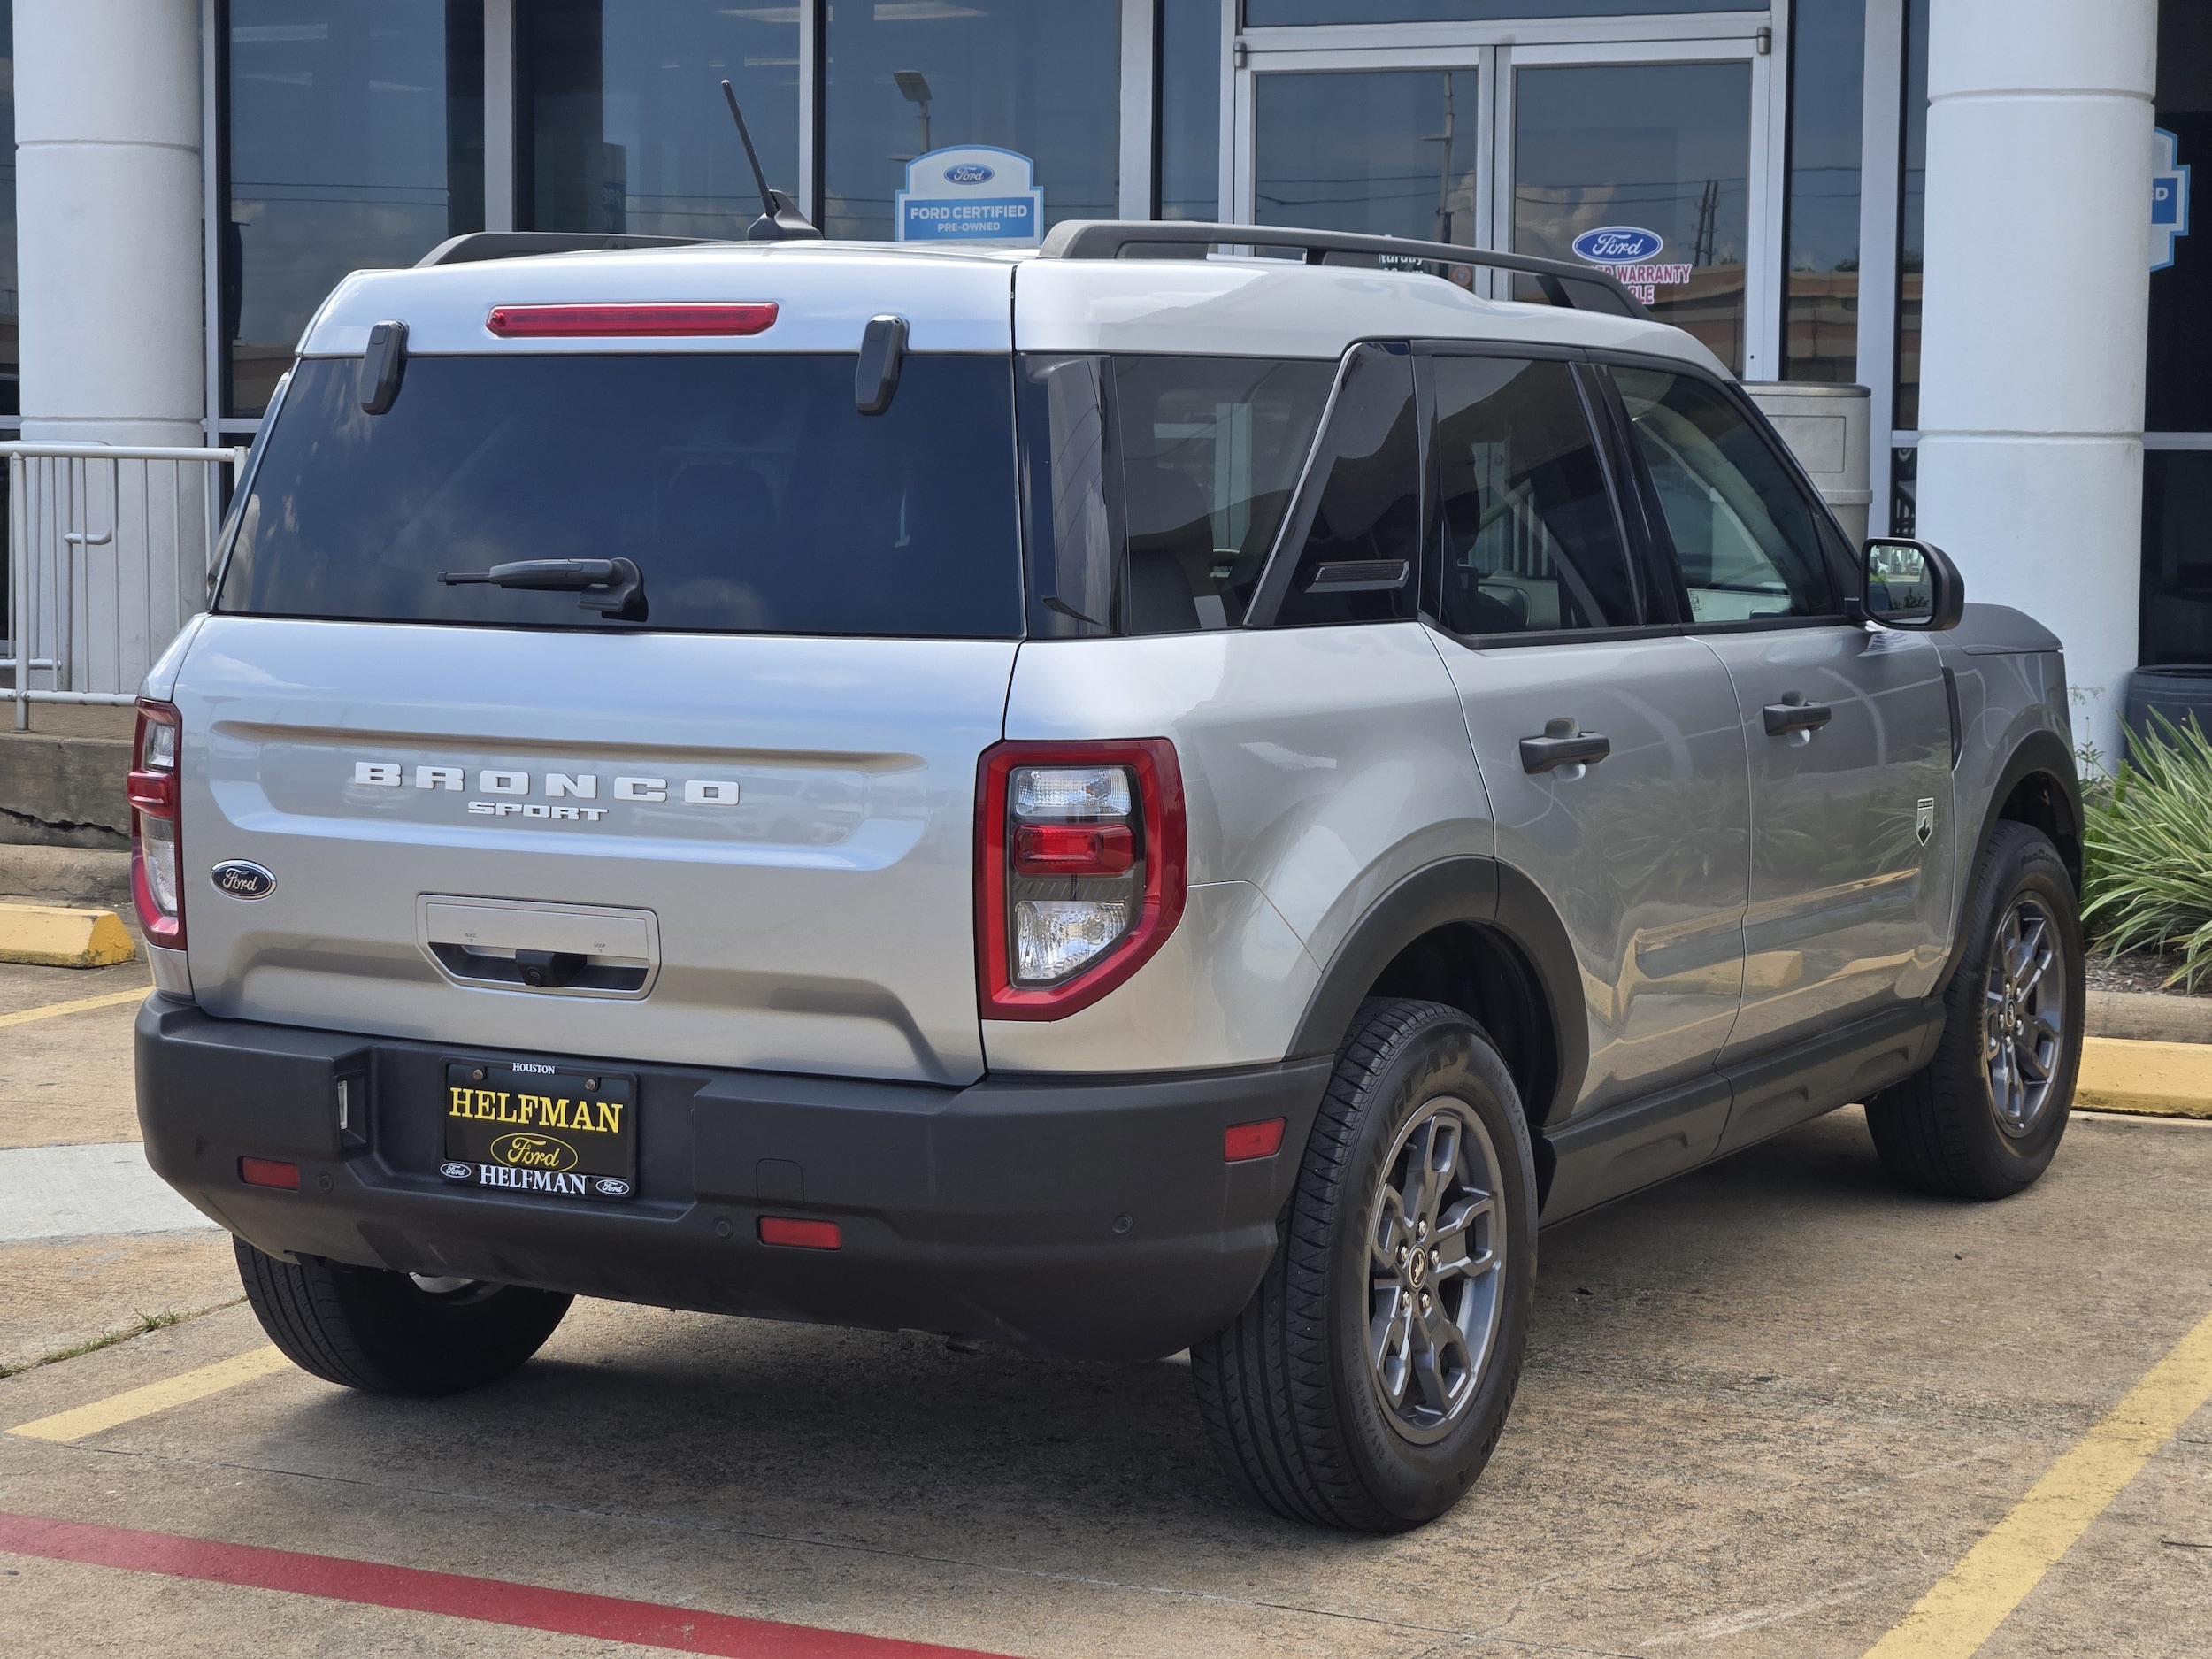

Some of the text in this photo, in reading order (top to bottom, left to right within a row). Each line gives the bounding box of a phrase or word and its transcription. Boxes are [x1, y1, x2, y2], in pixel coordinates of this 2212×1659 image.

[953, 166, 985, 181] Ford
[910, 204, 1028, 219] FORD CERTIFIED
[937, 221, 1001, 232] PRE-OWNED
[1592, 233, 1644, 255] Ford
[1617, 265, 1692, 283] WARRANTY
[355, 761, 741, 806] BRONCO
[468, 801, 609, 821] SPORT
[222, 867, 257, 891] Ford
[512, 1062, 556, 1075] HOUSTON
[449, 1087, 623, 1133] HELFMAN
[507, 1136, 561, 1167] Ford
[479, 1163, 588, 1194] HELFMAN
[601, 1179, 625, 1194] Ford
